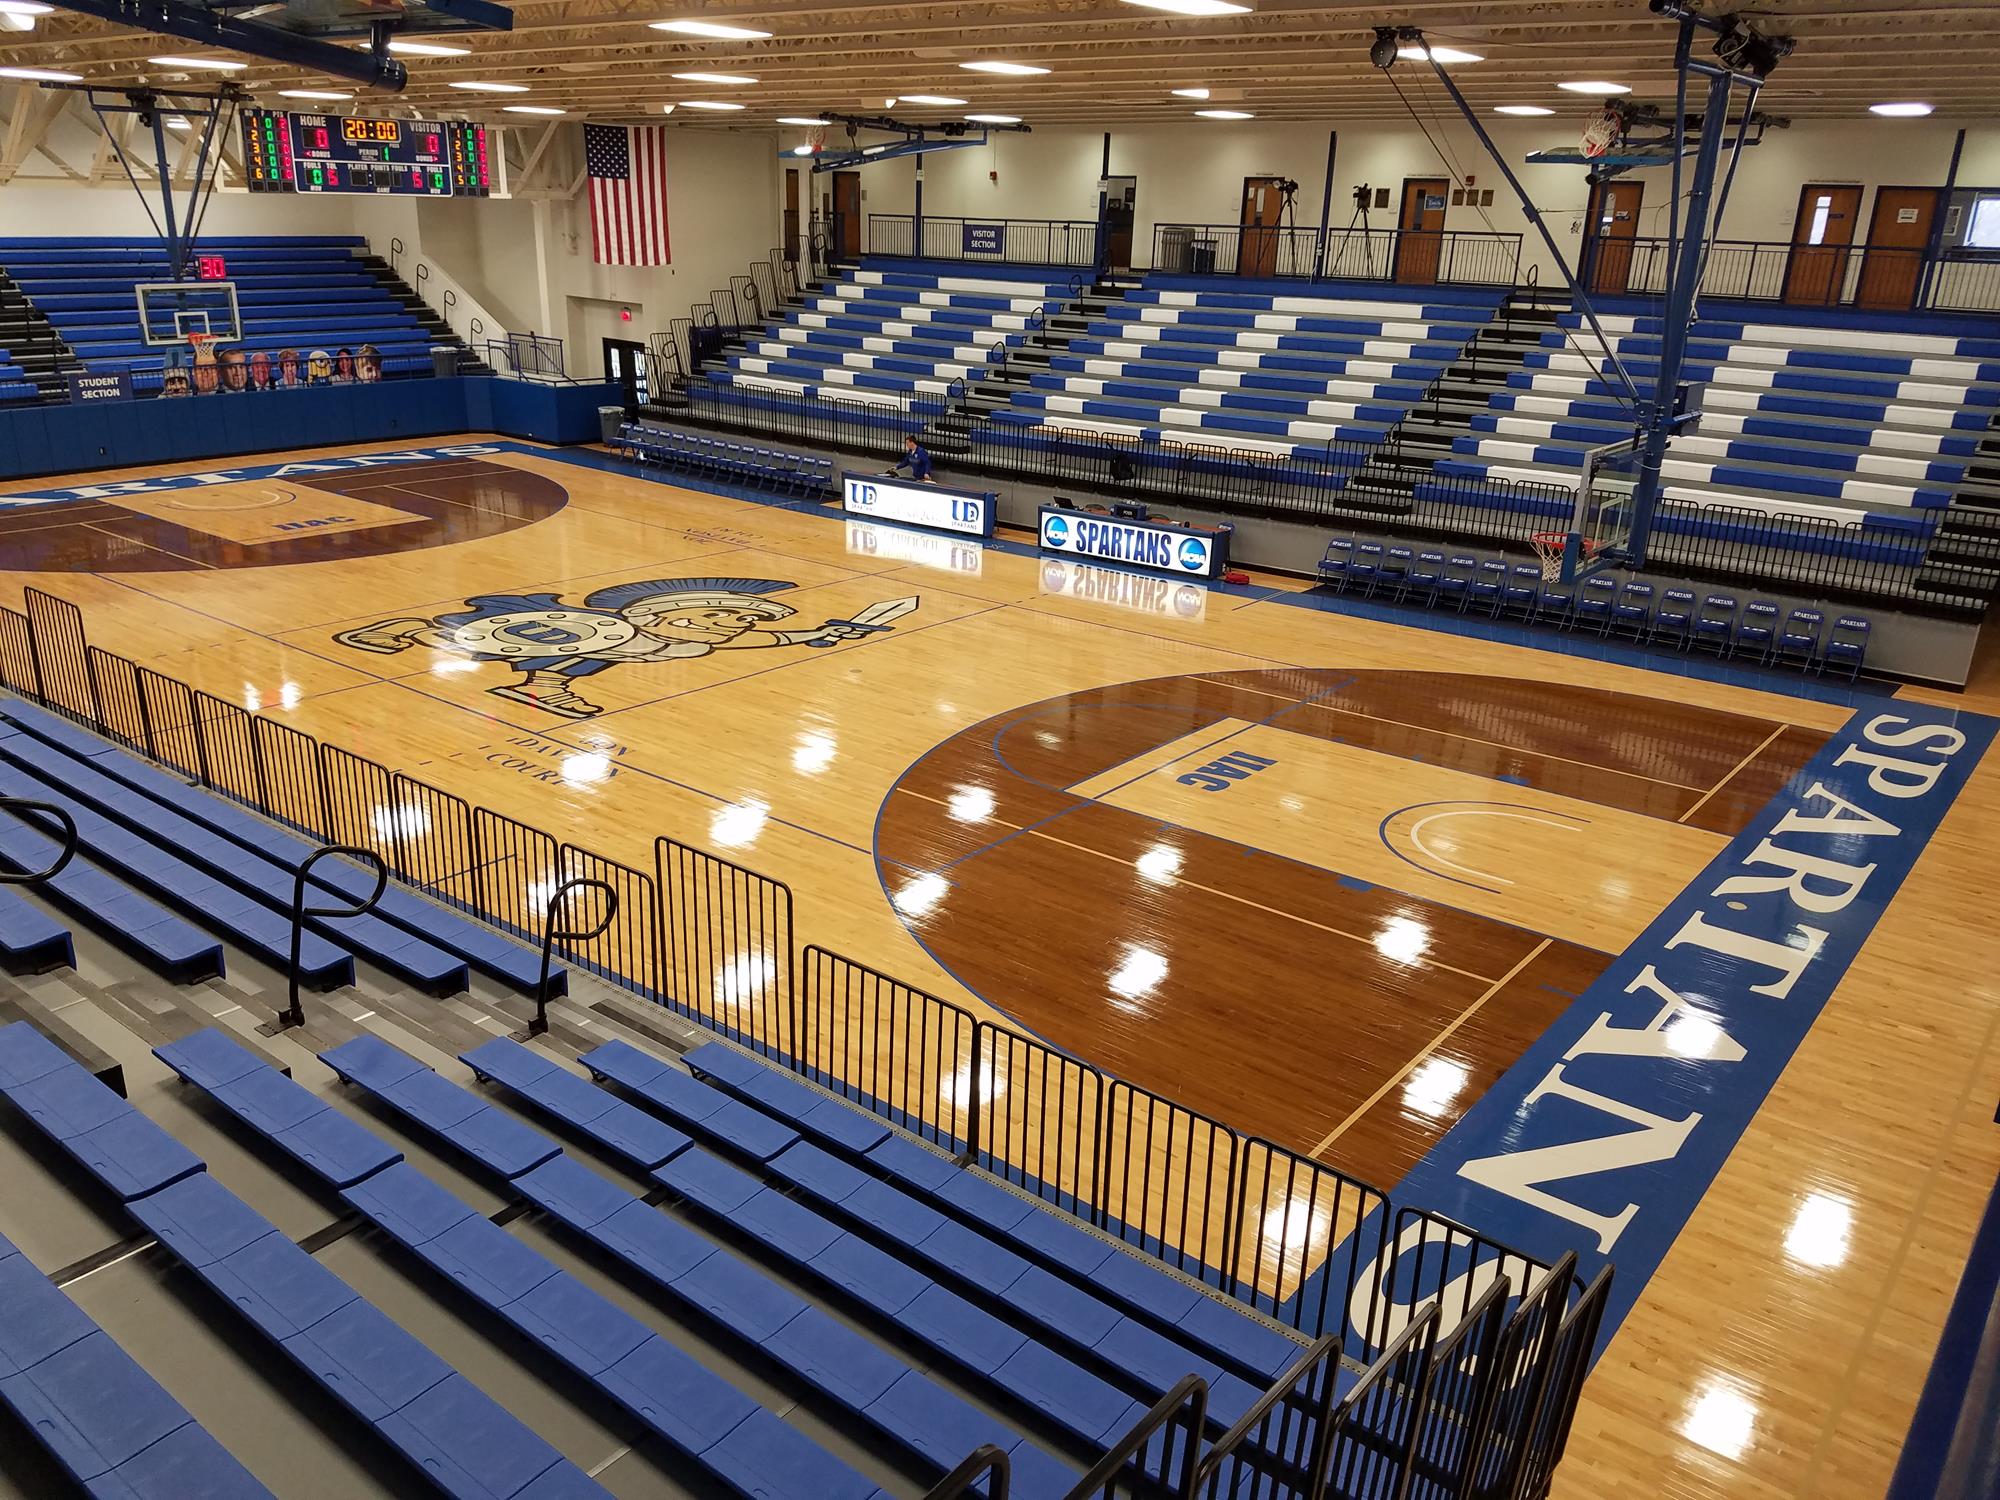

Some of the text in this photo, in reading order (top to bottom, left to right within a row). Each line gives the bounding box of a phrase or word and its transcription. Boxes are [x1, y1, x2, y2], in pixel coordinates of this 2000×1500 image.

[300, 116, 326, 126] HOME
[346, 120, 396, 140] 20:00
[410, 122, 441, 133] VISITOR
[312, 169, 323, 185] 0
[972, 230, 995, 238] VISITOR
[971, 240, 996, 248] SECTION
[201, 258, 224, 278] 30
[78, 376, 119, 388] STUDENT
[82, 388, 120, 399] SECTION
[1076, 520, 1172, 566] SPARTANS
[1708, 597, 1733, 606] SPARTANS
[1750, 604, 1775, 612] SPARTANS
[1794, 611, 1819, 620] SPARTANS
[1840, 619, 1866, 628] SPARTANS
[1176, 750, 1278, 792] IIAC
[1350, 713, 1967, 1391] SPARTANS
